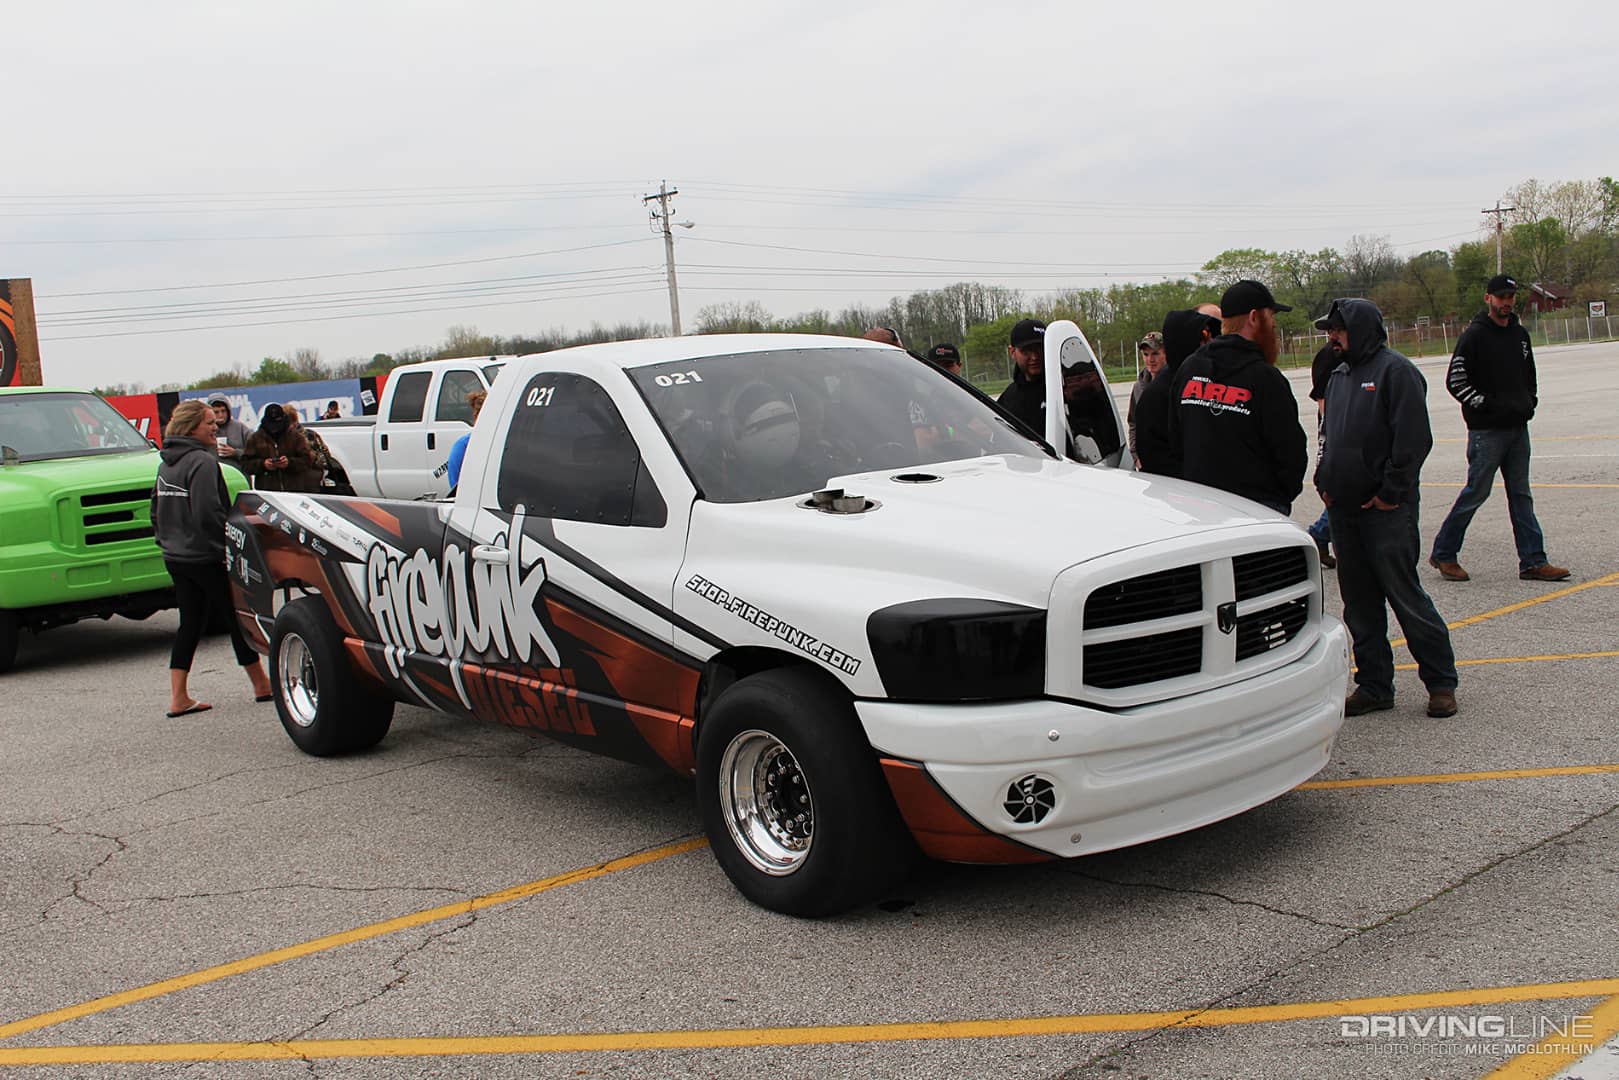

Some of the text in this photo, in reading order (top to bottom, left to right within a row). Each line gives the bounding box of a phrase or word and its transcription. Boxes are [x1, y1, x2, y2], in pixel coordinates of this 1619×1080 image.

[655, 370, 703, 387] 021
[526, 386, 555, 406] 021
[1181, 380, 1252, 405] ARP
[685, 574, 862, 676] SHOP.FIREPUNK.COM
